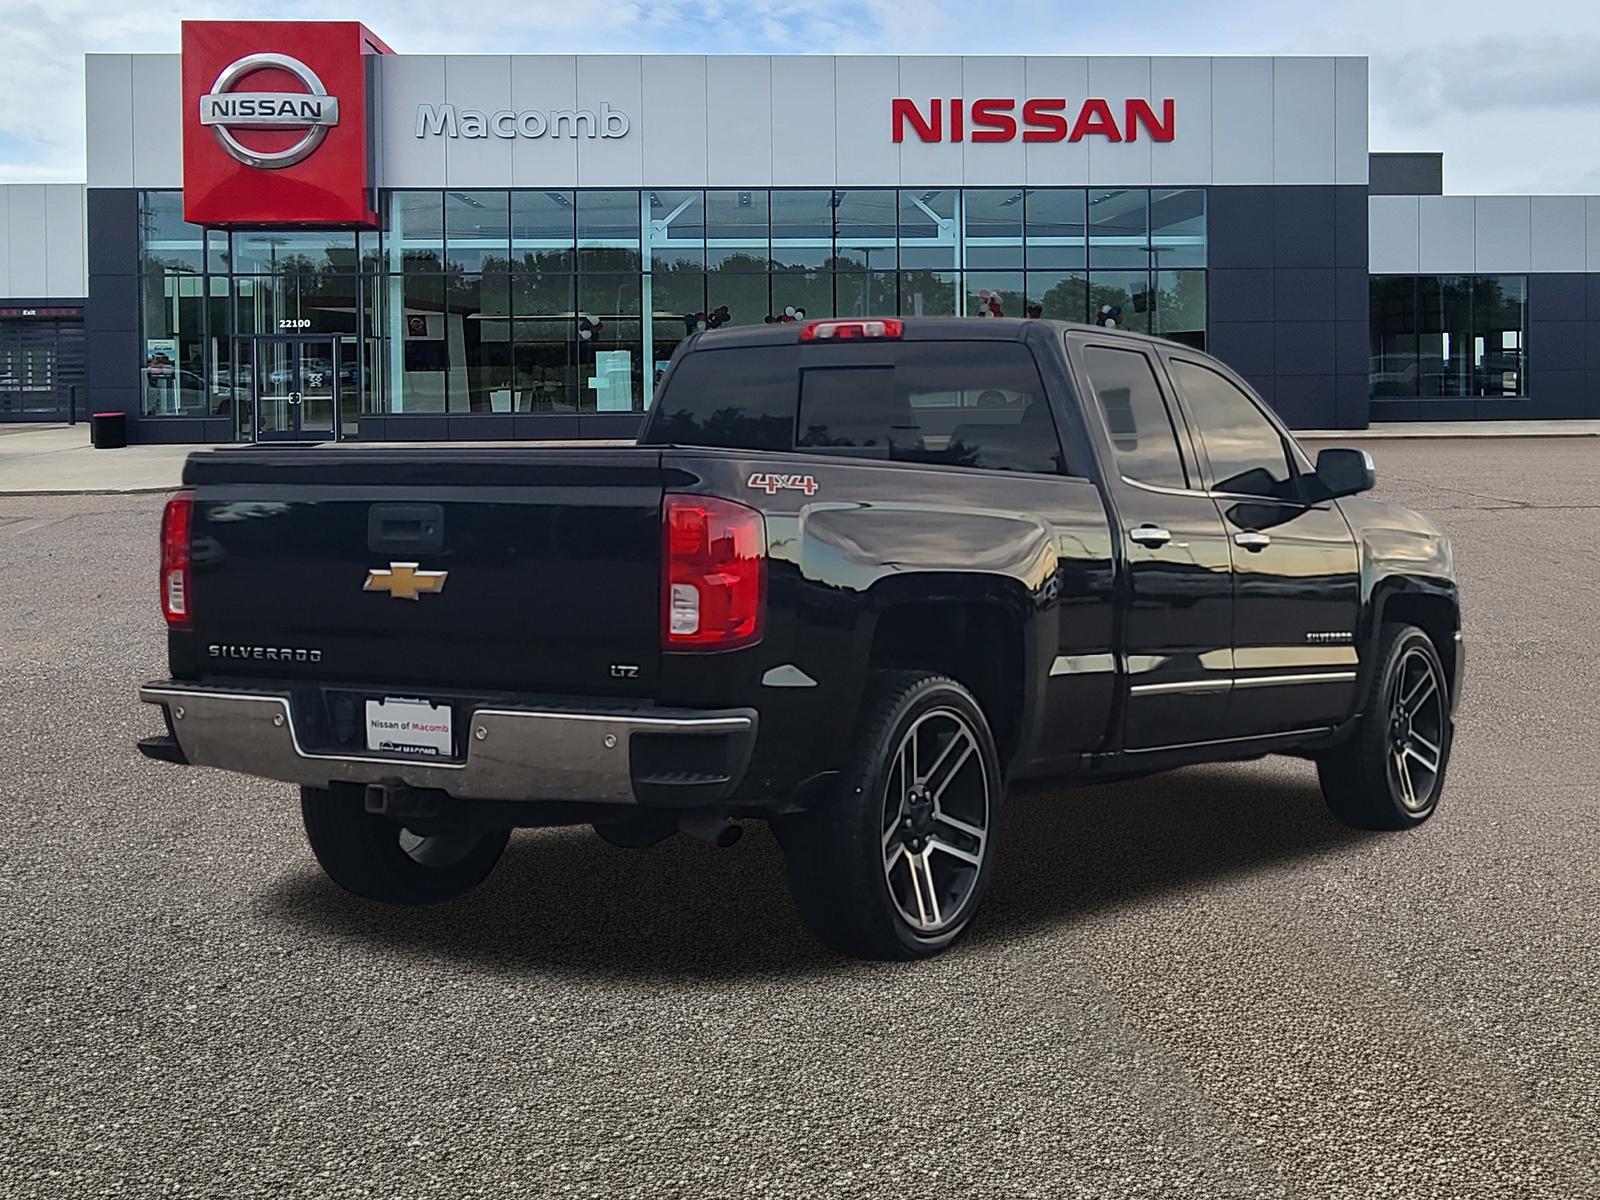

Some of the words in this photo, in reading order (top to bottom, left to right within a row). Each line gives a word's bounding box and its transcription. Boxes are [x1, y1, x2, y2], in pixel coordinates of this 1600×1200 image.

[211, 100, 322, 118] NISSAN
[415, 101, 631, 139] Macomb
[892, 98, 1175, 143] NISSAN
[279, 319, 311, 328] 22100
[208, 644, 322, 662] SILVERADO
[610, 664, 639, 678] LTZ
[370, 719, 399, 730] Nissan
[400, 720, 410, 730] of
[411, 722, 449, 733] Macomb
